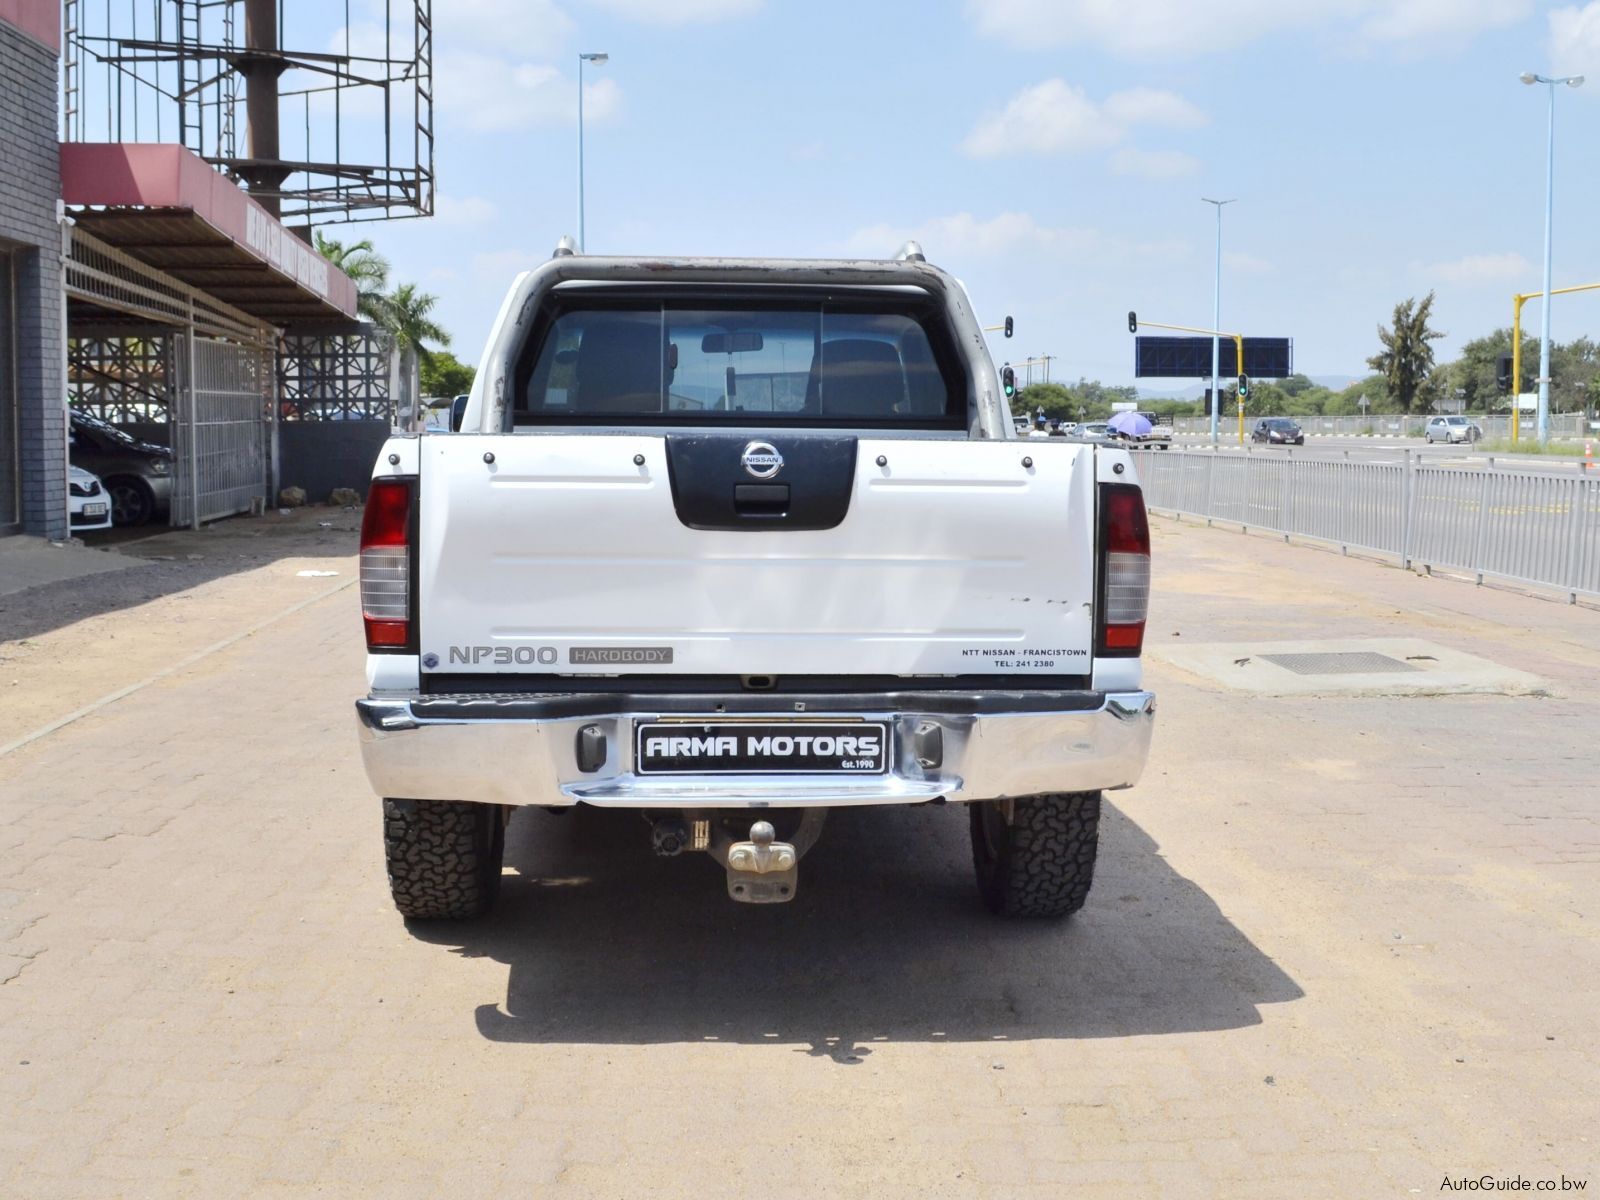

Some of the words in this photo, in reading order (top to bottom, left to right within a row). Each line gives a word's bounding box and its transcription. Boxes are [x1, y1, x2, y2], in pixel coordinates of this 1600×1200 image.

[450, 646, 558, 664] NP300
[574, 649, 668, 662] HARDBODY
[646, 737, 738, 757] ARMA
[747, 736, 880, 756] MOTORS
